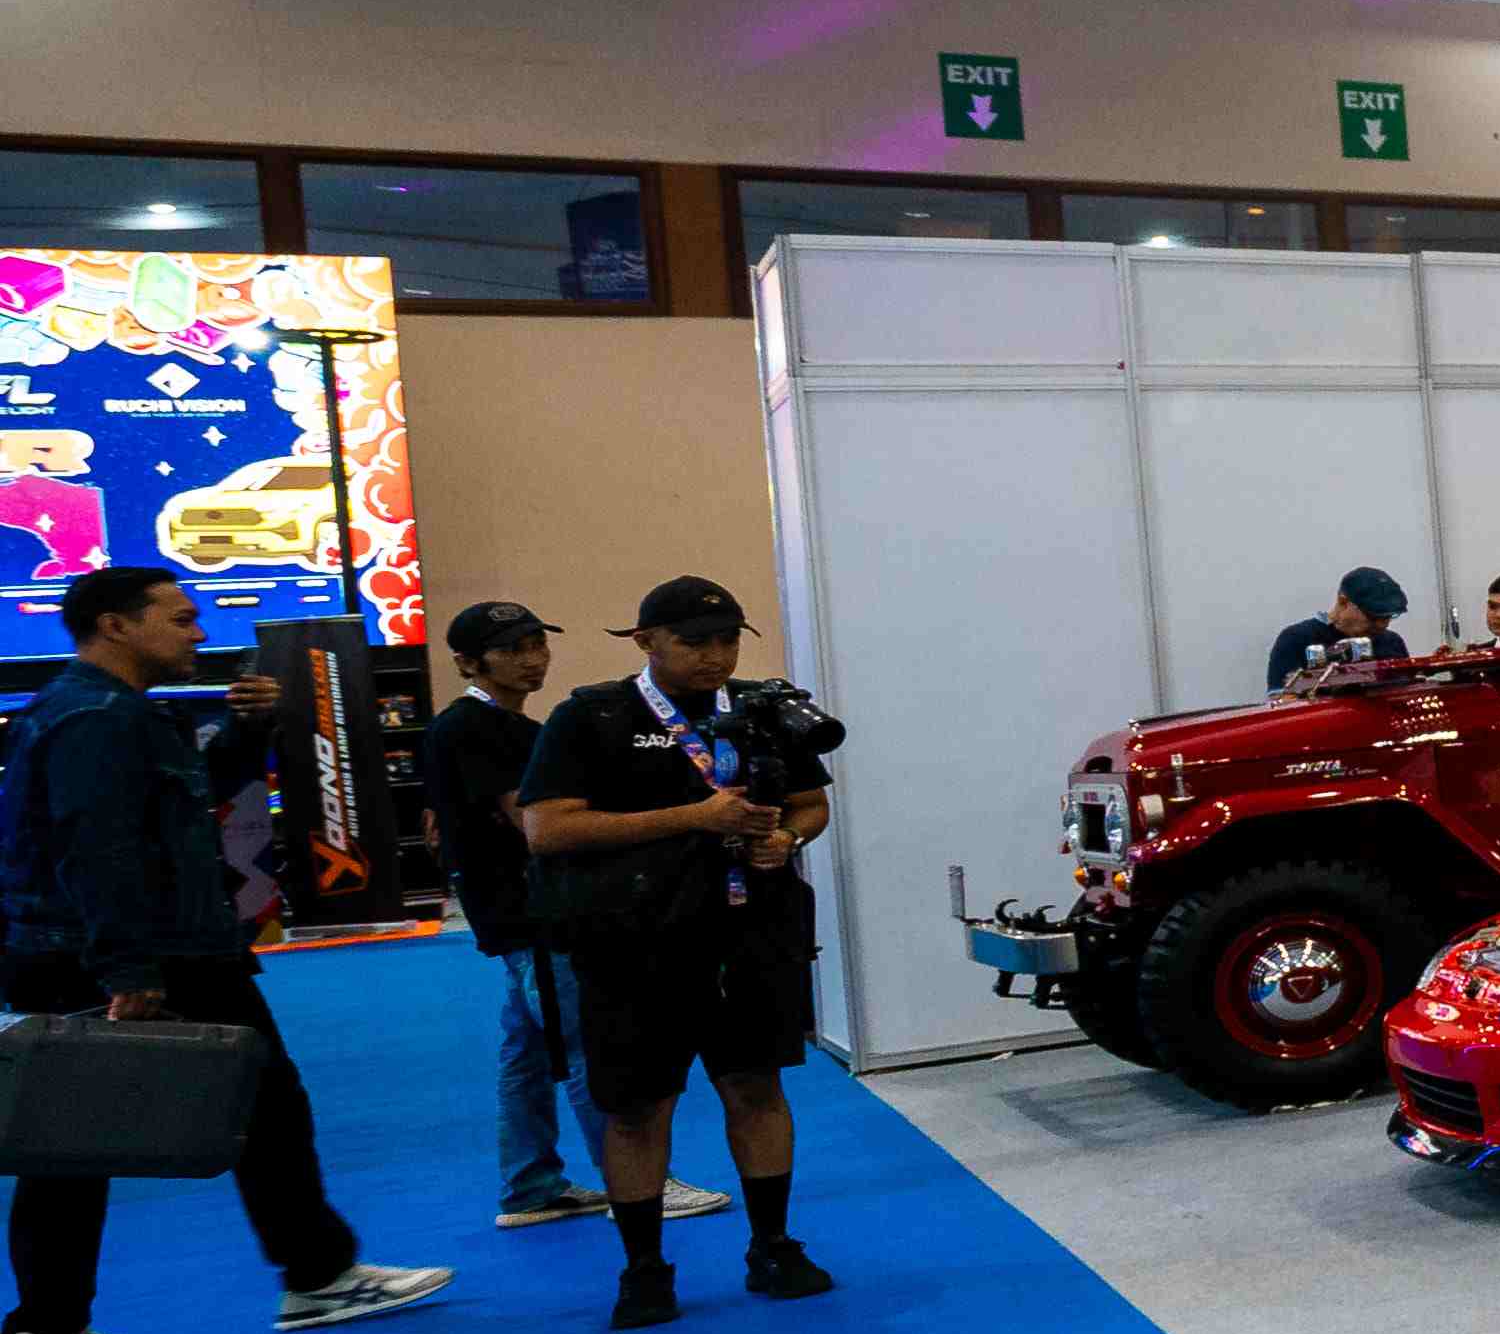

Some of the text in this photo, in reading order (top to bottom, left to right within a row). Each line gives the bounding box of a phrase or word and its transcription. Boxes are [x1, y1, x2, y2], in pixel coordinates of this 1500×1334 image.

[946, 64, 1013, 86] EXIT
[1343, 90, 1400, 110] EXIT
[1285, 759, 1342, 775] TOYOTA
